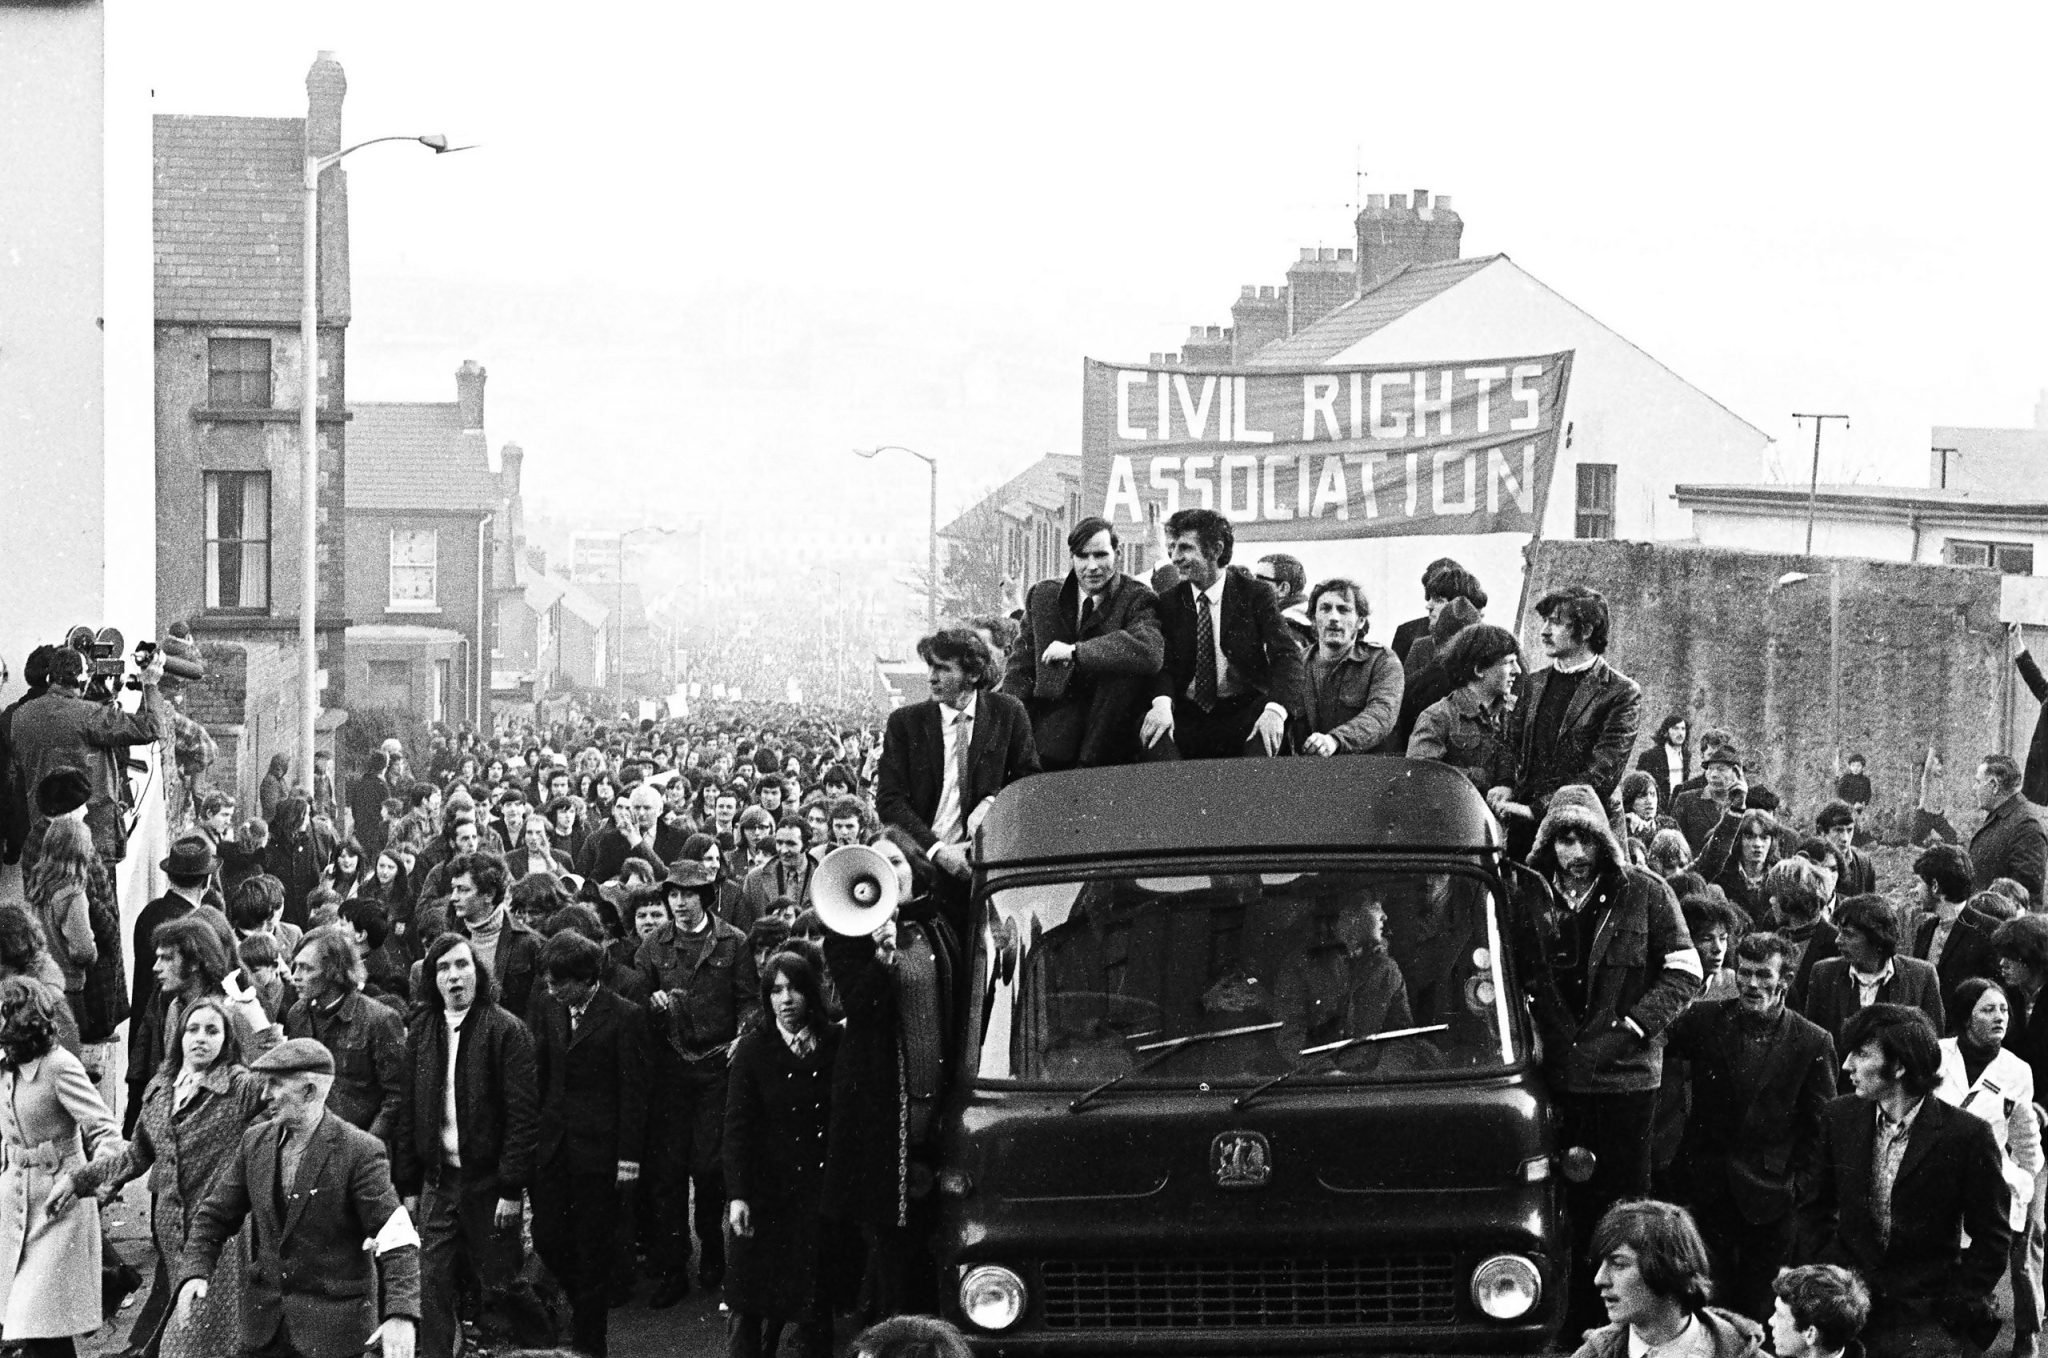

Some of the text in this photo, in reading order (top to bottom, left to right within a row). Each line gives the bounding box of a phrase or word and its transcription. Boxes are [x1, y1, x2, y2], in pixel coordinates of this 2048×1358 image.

[1116, 365, 1543, 443] CIVIL RIGHTS
[1102, 446, 1535, 523] ASSOCIATION
